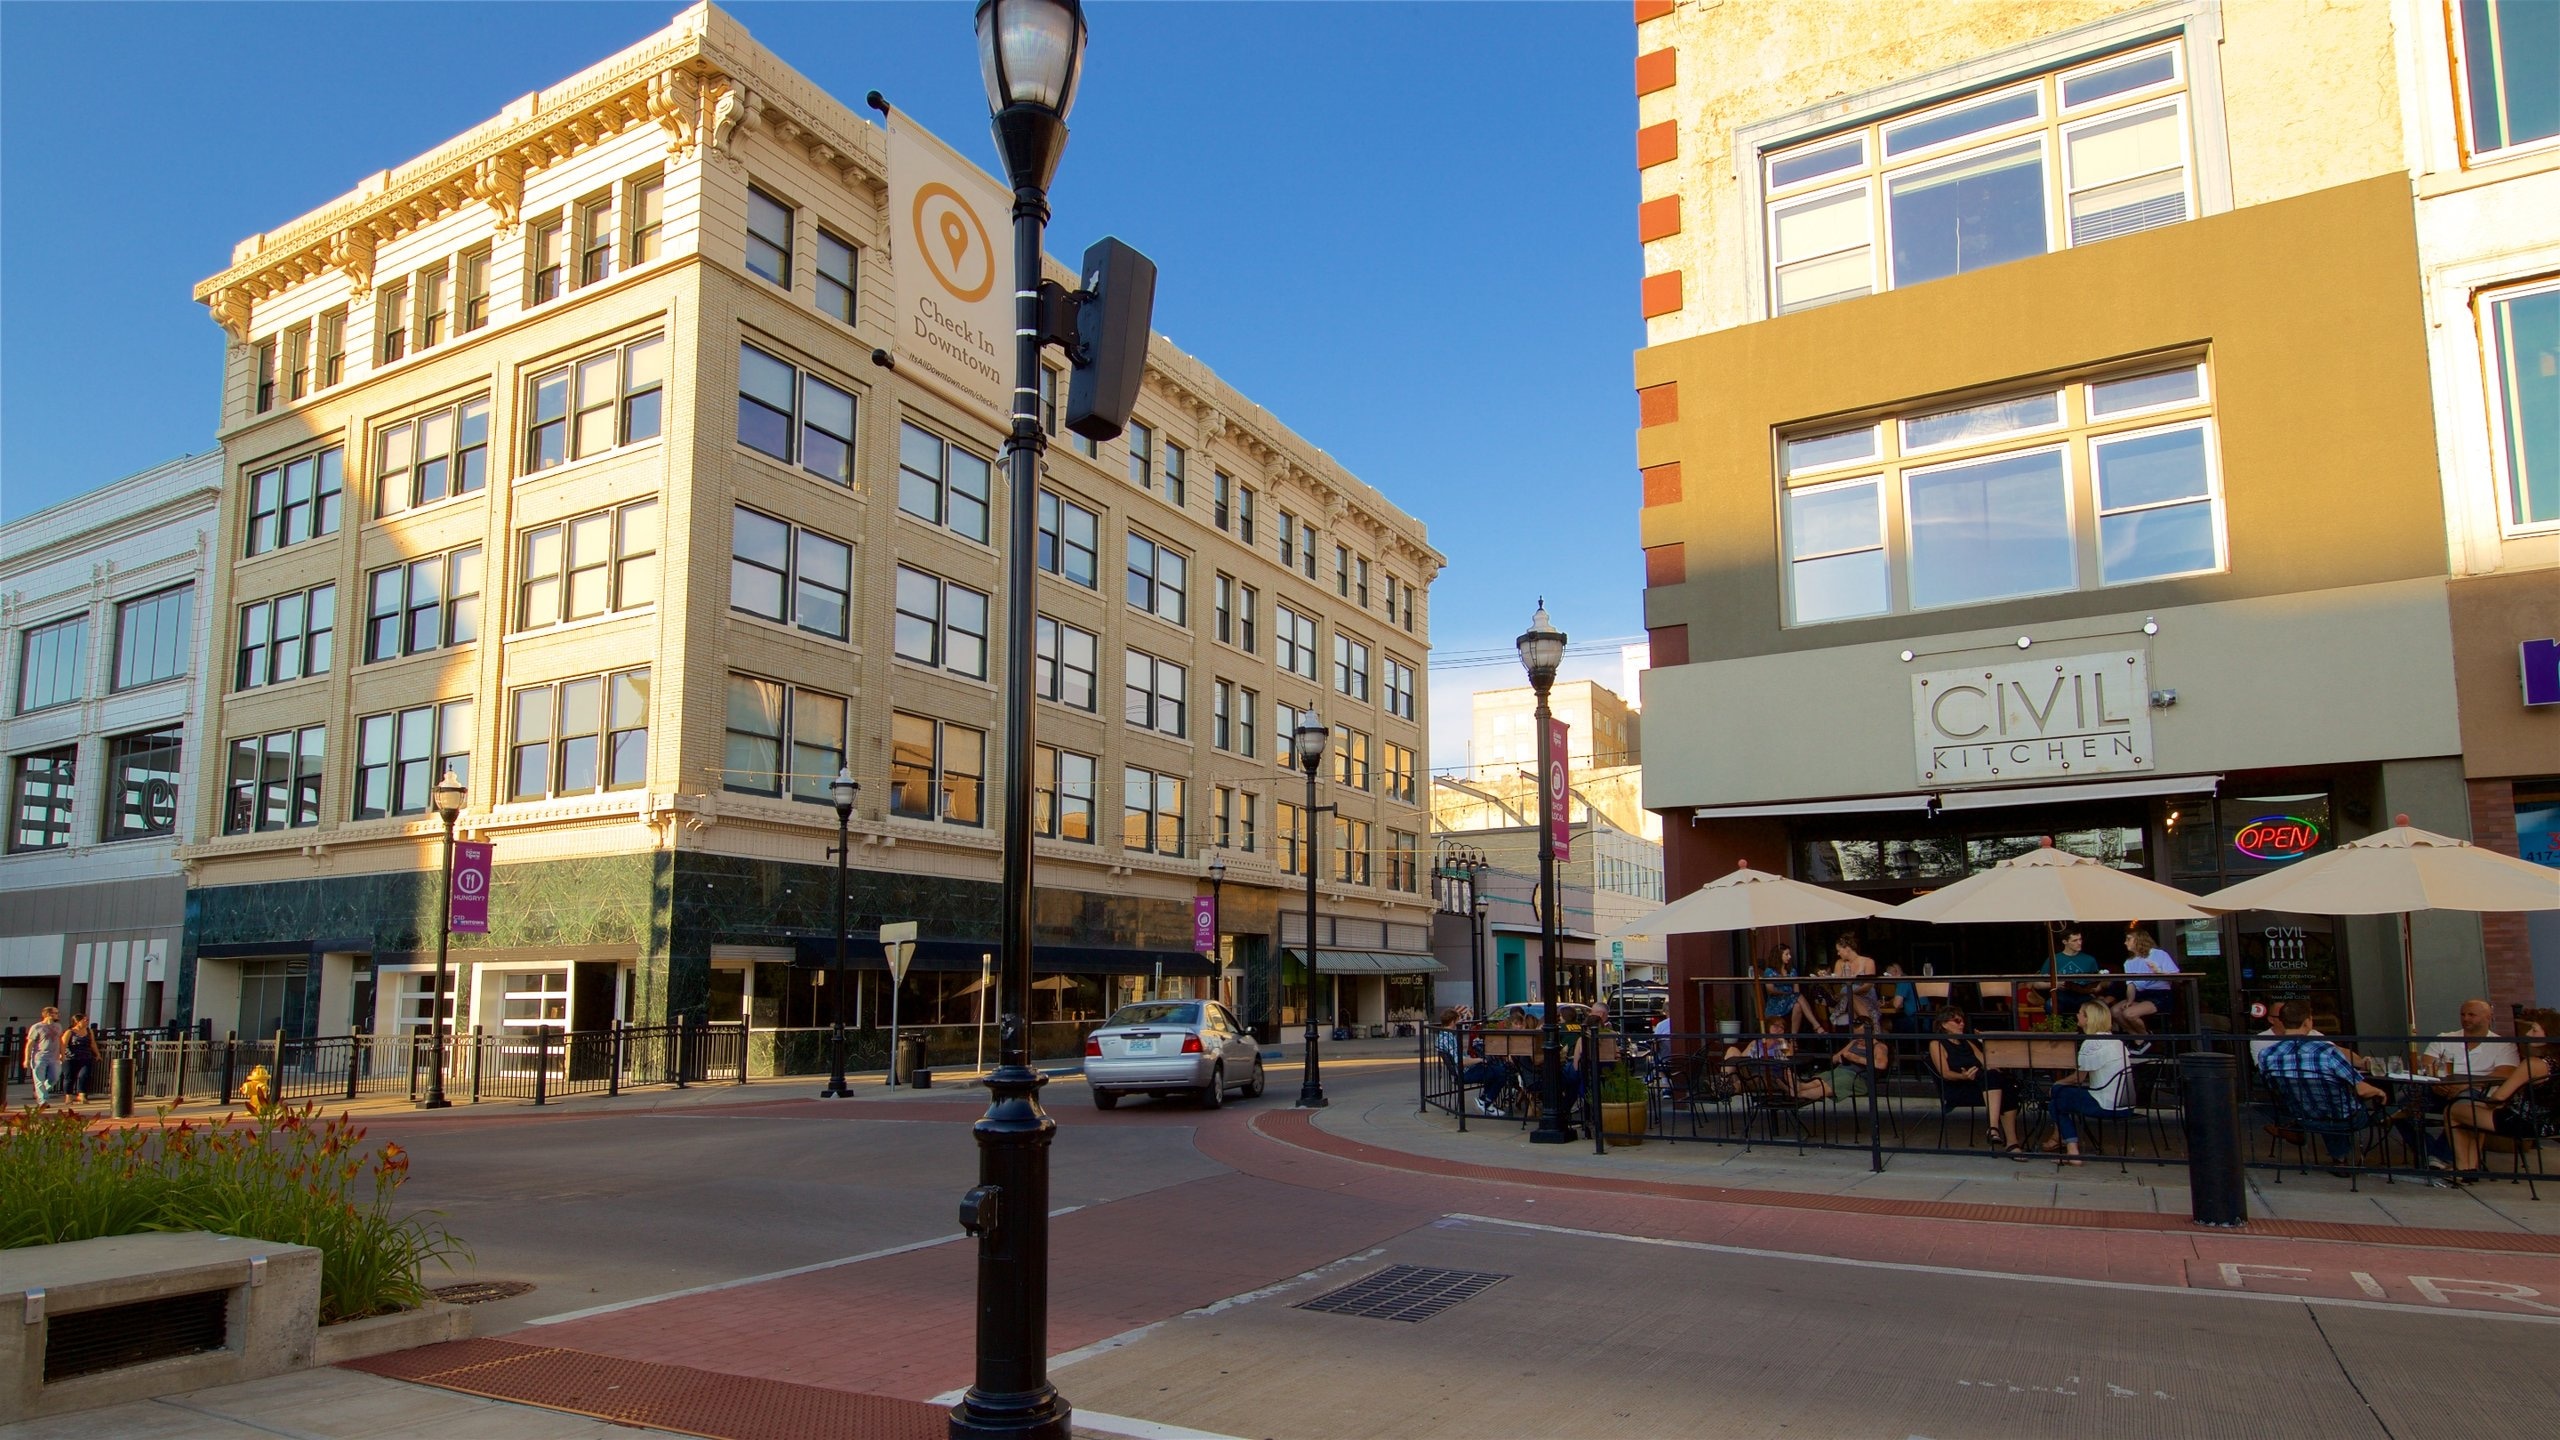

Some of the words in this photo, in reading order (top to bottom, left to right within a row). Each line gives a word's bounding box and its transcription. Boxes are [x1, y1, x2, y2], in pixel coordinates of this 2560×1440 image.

[919, 296, 974, 344] Check
[978, 330, 996, 357] In
[913, 315, 1001, 385] Downtown
[908, 352, 999, 410] ItsAllDowntown.com/checkin
[1931, 673, 2130, 740] CIVIL
[1933, 736, 2132, 770] KITCHEN
[2240, 826, 2311, 849] OPEN
[453, 894, 486, 902] HUNGRY?
[2265, 926, 2307, 939] CIVIL
[2268, 960, 2308, 970] KITCHEN
